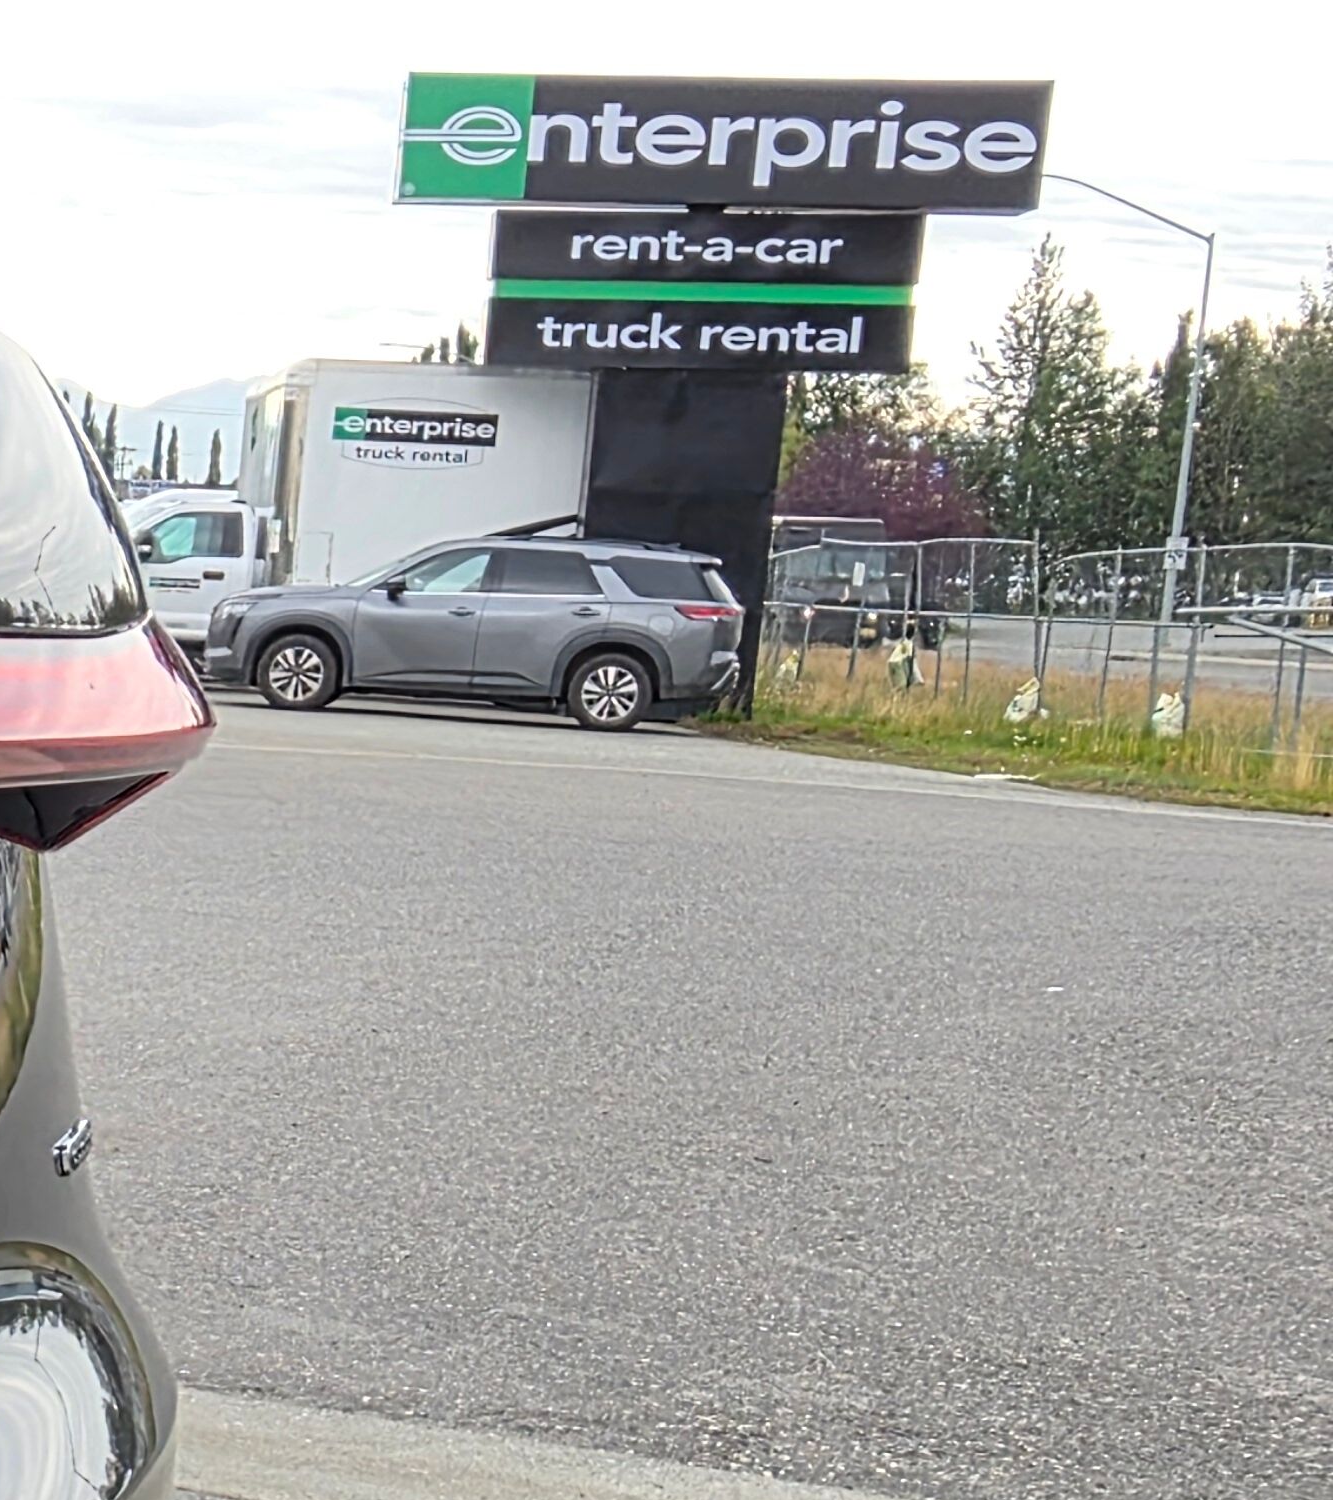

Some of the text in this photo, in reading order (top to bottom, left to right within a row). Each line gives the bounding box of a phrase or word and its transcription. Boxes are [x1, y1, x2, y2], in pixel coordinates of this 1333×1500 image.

[403, 100, 1038, 187] enterprise
[570, 230, 844, 265] rent-a-car
[538, 313, 864, 355] truck rental
[334, 416, 495, 440] enterprise
[356, 446, 468, 463] truck rental
